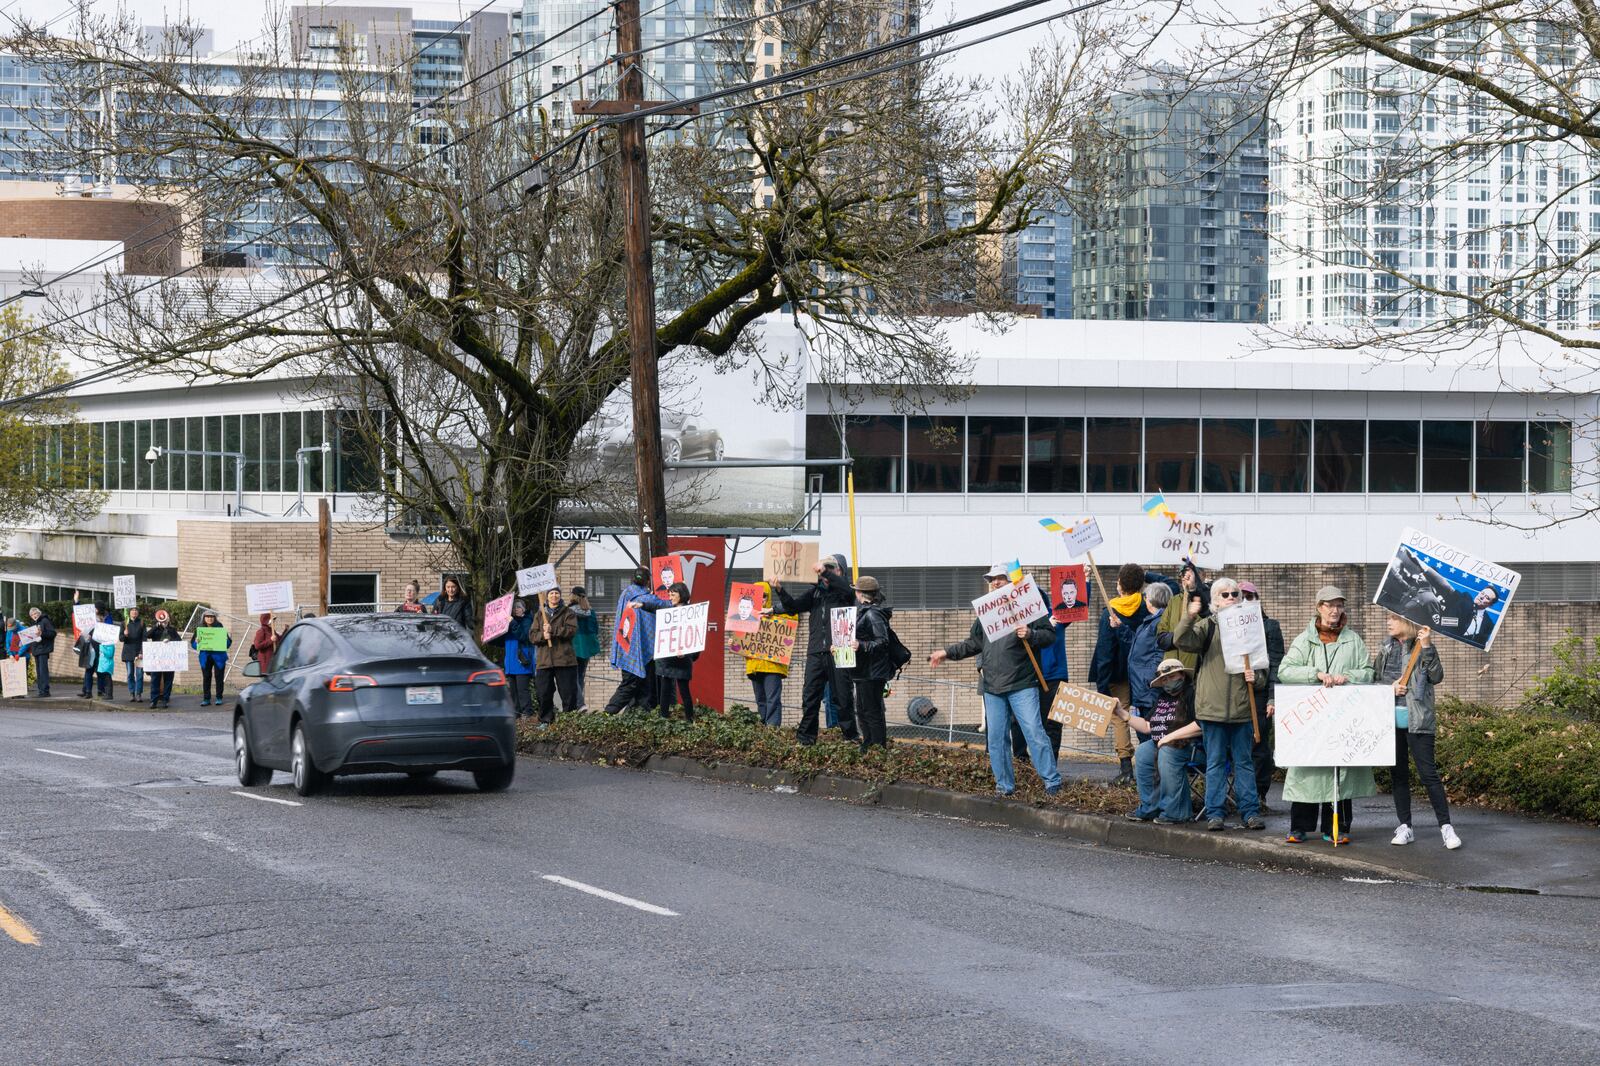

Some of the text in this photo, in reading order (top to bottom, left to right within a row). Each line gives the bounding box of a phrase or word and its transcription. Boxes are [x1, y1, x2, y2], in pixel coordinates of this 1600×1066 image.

[1168, 519, 1214, 537] MUSK
[770, 540, 803, 559] STOP
[1161, 538, 1210, 555] OR US
[1409, 531, 1516, 586] BOYCOTT TESLA!
[526, 569, 548, 580] Save
[773, 559, 801, 577] DOGE
[1058, 569, 1077, 579] I AM
[520, 579, 555, 591] Democracy
[740, 587, 756, 596] I AM
[977, 582, 1031, 616] HANDS OFF
[997, 600, 1020, 616] OUR
[664, 602, 709, 625] DEPORT
[986, 600, 1042, 635] DEMOCRACY
[1226, 612, 1259, 628] ELBOWS
[656, 623, 706, 654] FELON
[774, 622, 792, 637] YOU
[740, 639, 786, 658] WORKERS
[745, 631, 785, 648] FEDERAL
[1062, 685, 1113, 711] NO KING
[1056, 699, 1105, 724] NO DOGE
[1280, 687, 1329, 736] FIGHT
[1053, 711, 1097, 733] NO ICE
